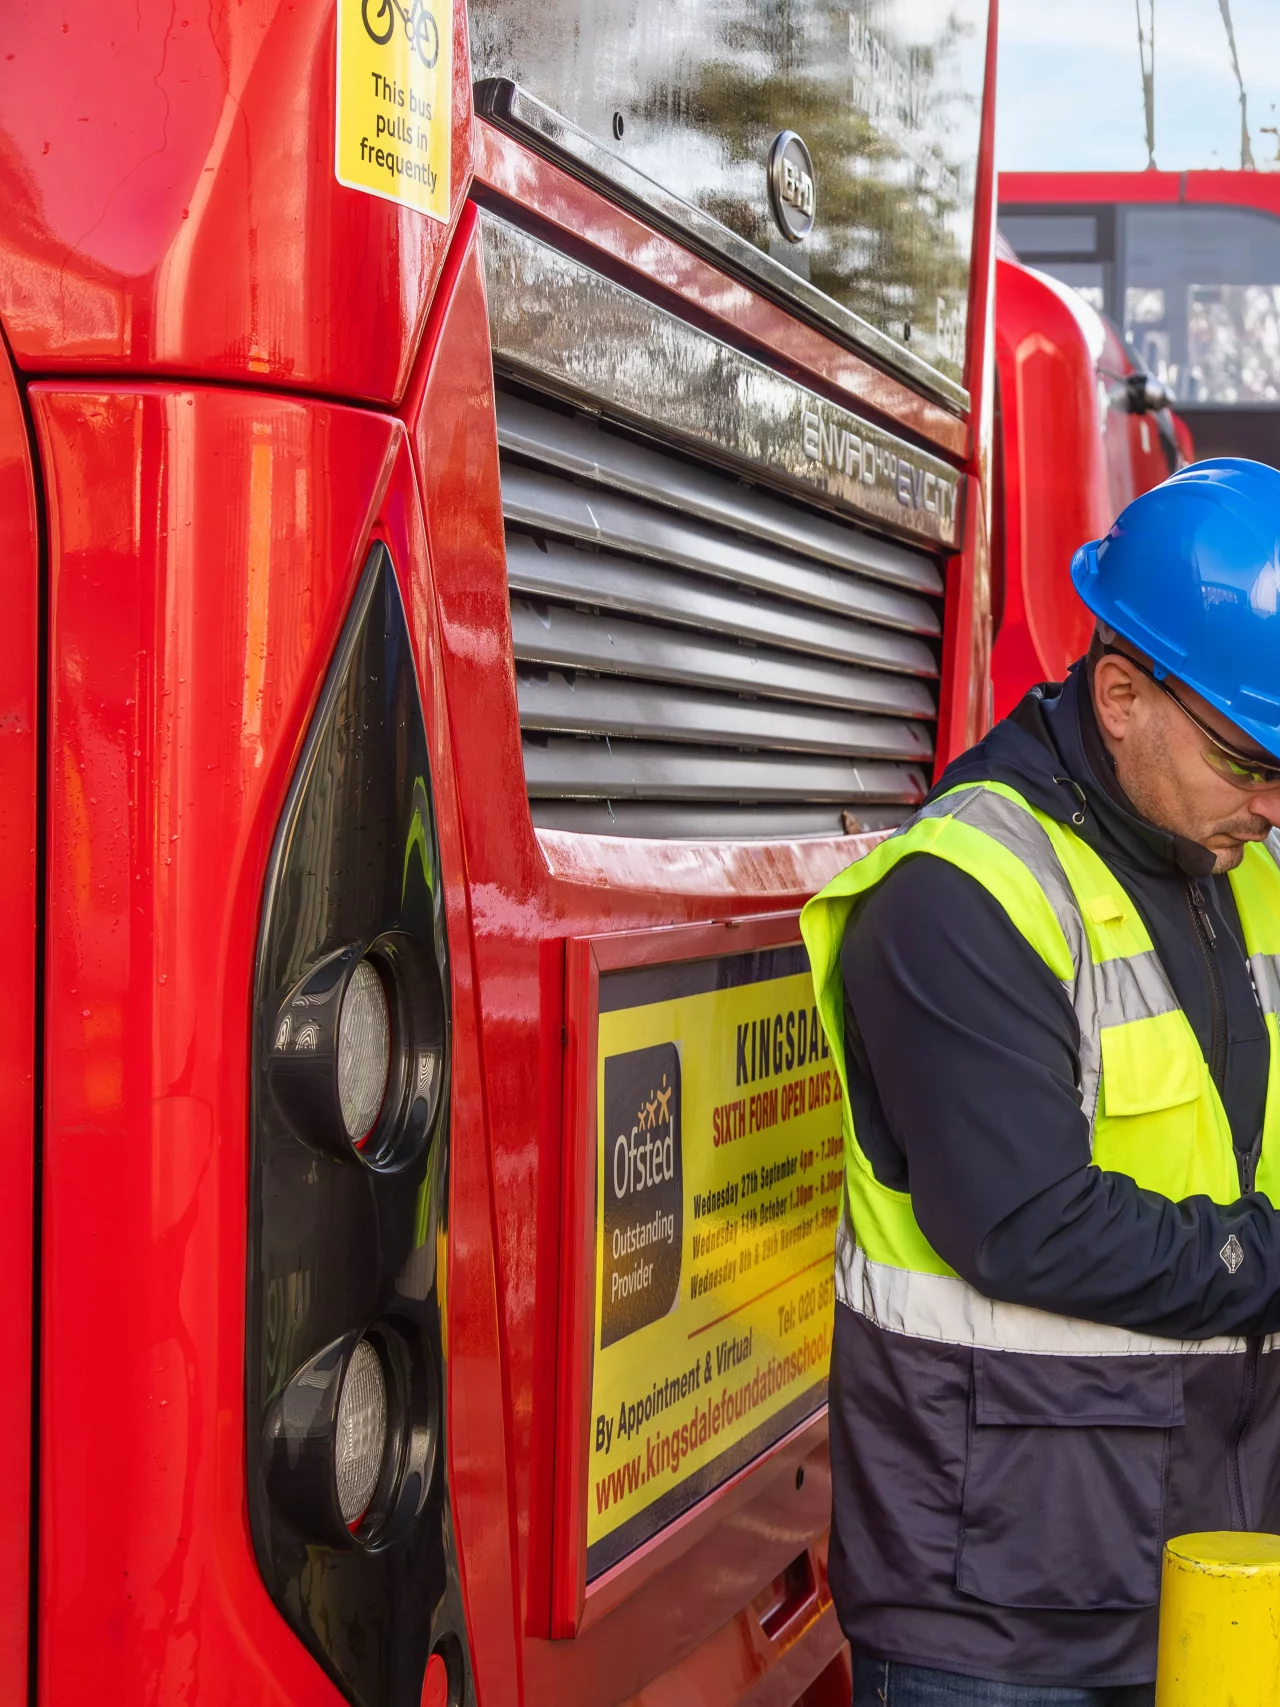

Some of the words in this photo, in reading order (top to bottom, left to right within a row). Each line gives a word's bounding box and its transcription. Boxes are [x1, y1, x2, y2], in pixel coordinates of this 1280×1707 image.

[371, 71, 404, 107] This
[409, 88, 432, 121] bus
[360, 137, 437, 194] frequently
[376, 114, 413, 145] pulls
[416, 127, 428, 152] in
[736, 1006, 830, 1087] KINGSDAL
[713, 1099, 745, 1148] SIXTH
[749, 1088, 778, 1134] FORM
[781, 1078, 805, 1122] OPEN
[808, 1070, 831, 1112] DAYS
[613, 1115, 674, 1199] Ofsted
[693, 1181, 738, 1220] Wednesday
[741, 1169, 758, 1199] 27th
[760, 1156, 797, 1191] September
[799, 1149, 814, 1175] 4pm
[612, 1211, 674, 1260] Outstanding
[690, 1258, 737, 1300] Wednesday
[739, 1251, 752, 1274] 8th
[762, 1234, 778, 1261] 29th
[780, 1217, 813, 1247] November
[692, 1219, 738, 1260] Wednesday
[741, 1208, 757, 1235] 11th
[760, 1195, 787, 1227] October
[611, 1261, 654, 1304] Provider
[778, 1299, 796, 1338] Tel:
[798, 1287, 816, 1324] 020
[595, 1414, 614, 1455] By
[617, 1358, 700, 1441] Appointment
[703, 1351, 712, 1385] &
[716, 1326, 753, 1376] Virtual
